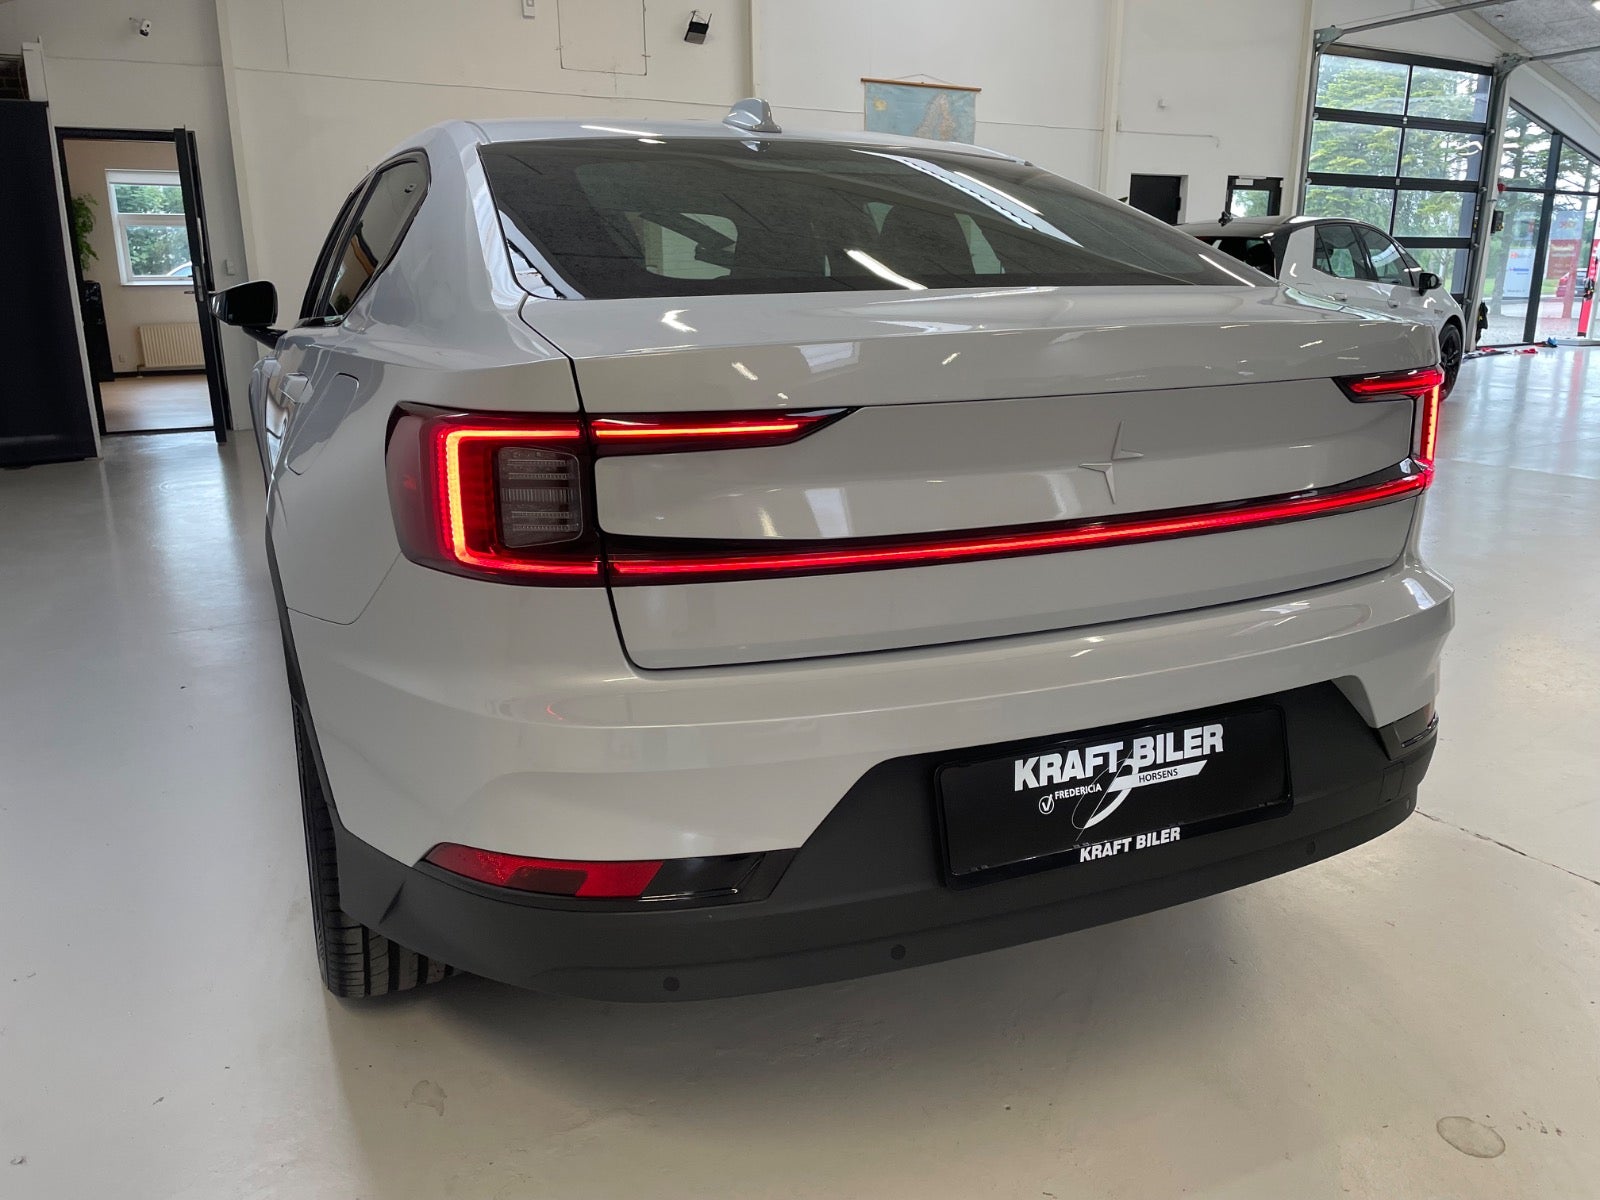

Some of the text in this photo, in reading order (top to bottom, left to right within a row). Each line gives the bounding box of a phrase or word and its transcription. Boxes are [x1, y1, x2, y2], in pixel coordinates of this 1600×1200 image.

[1014, 723, 1224, 792] KRAFT BILER
[1138, 768, 1179, 784] HORSENS
[1054, 782, 1103, 800] FREDERICIA
[1079, 826, 1181, 862] KRAFT BILER
